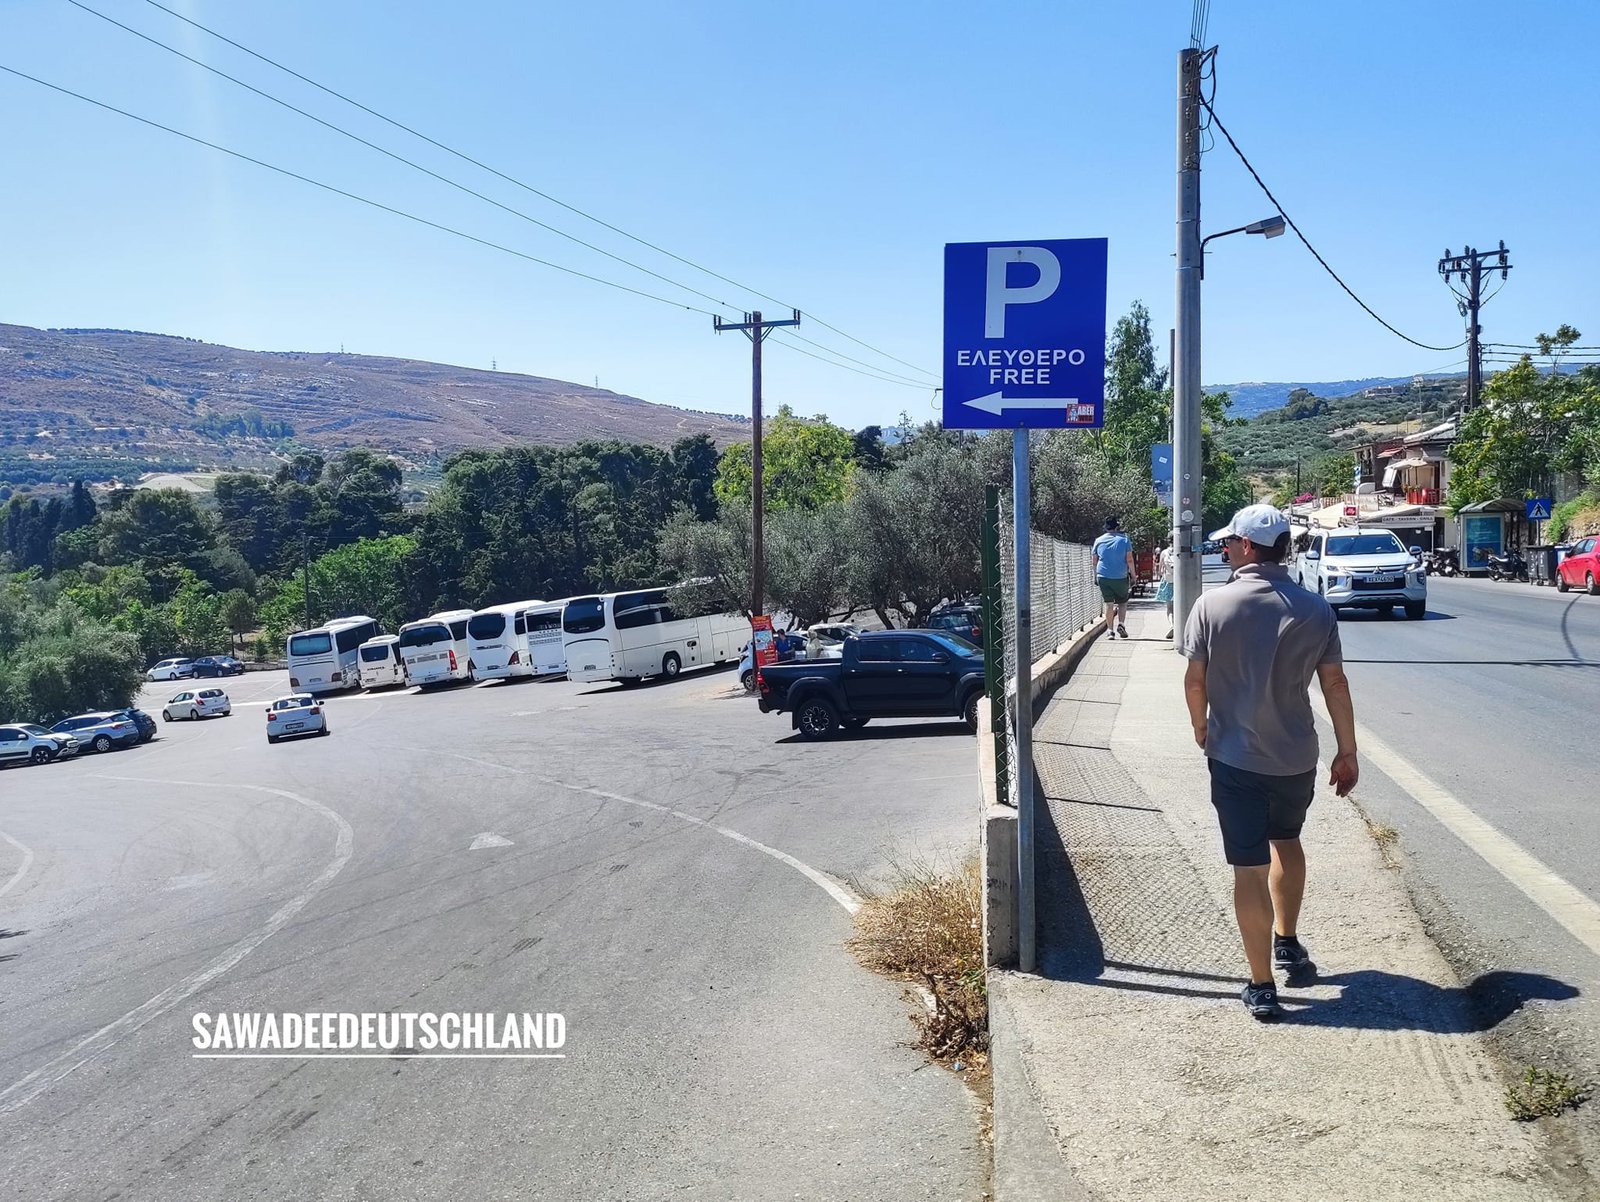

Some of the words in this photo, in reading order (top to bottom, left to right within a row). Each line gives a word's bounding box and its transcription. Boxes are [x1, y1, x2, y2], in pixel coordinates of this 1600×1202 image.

[984, 246, 1061, 339] P
[957, 348, 1085, 366] ΕΛΕΥΘΕΡΟ
[989, 368, 1051, 385] FREE
